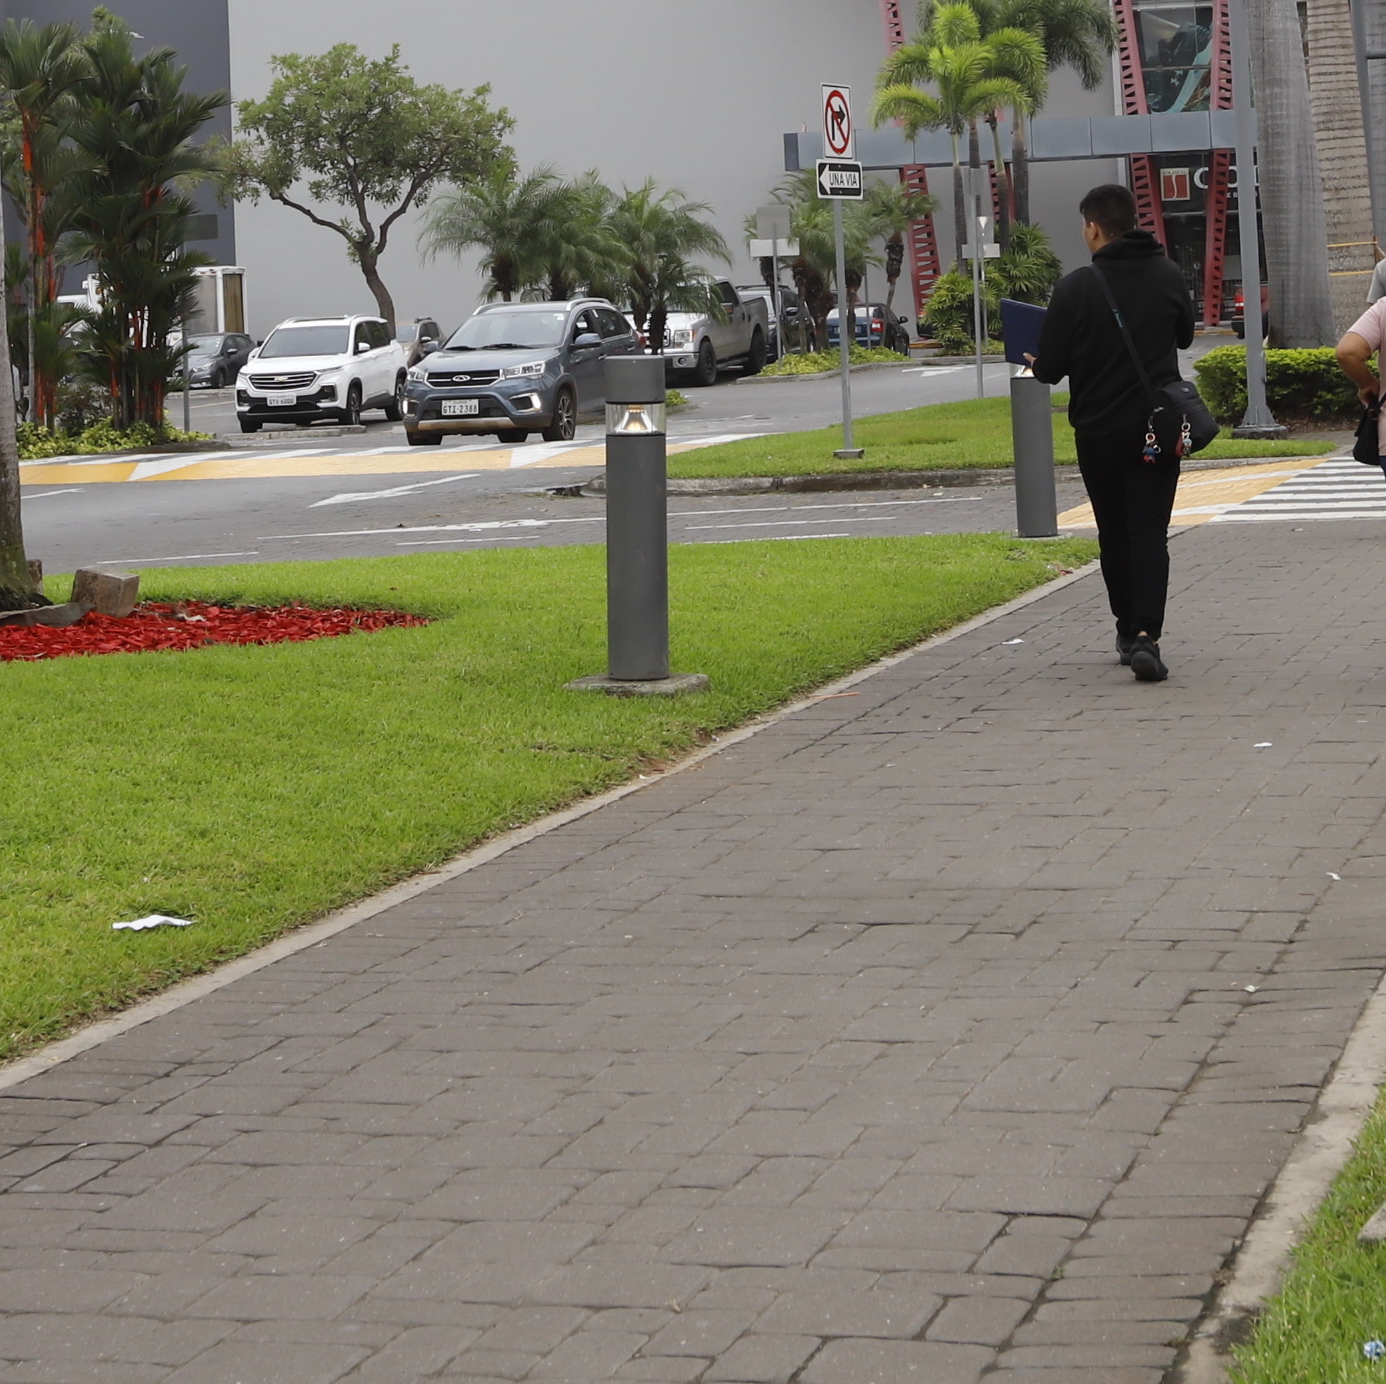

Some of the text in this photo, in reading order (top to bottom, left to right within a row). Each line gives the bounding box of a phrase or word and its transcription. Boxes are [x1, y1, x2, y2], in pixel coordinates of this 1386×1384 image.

[828, 172, 857, 186] UNA VIA
[443, 404, 478, 414] GTI-2388
